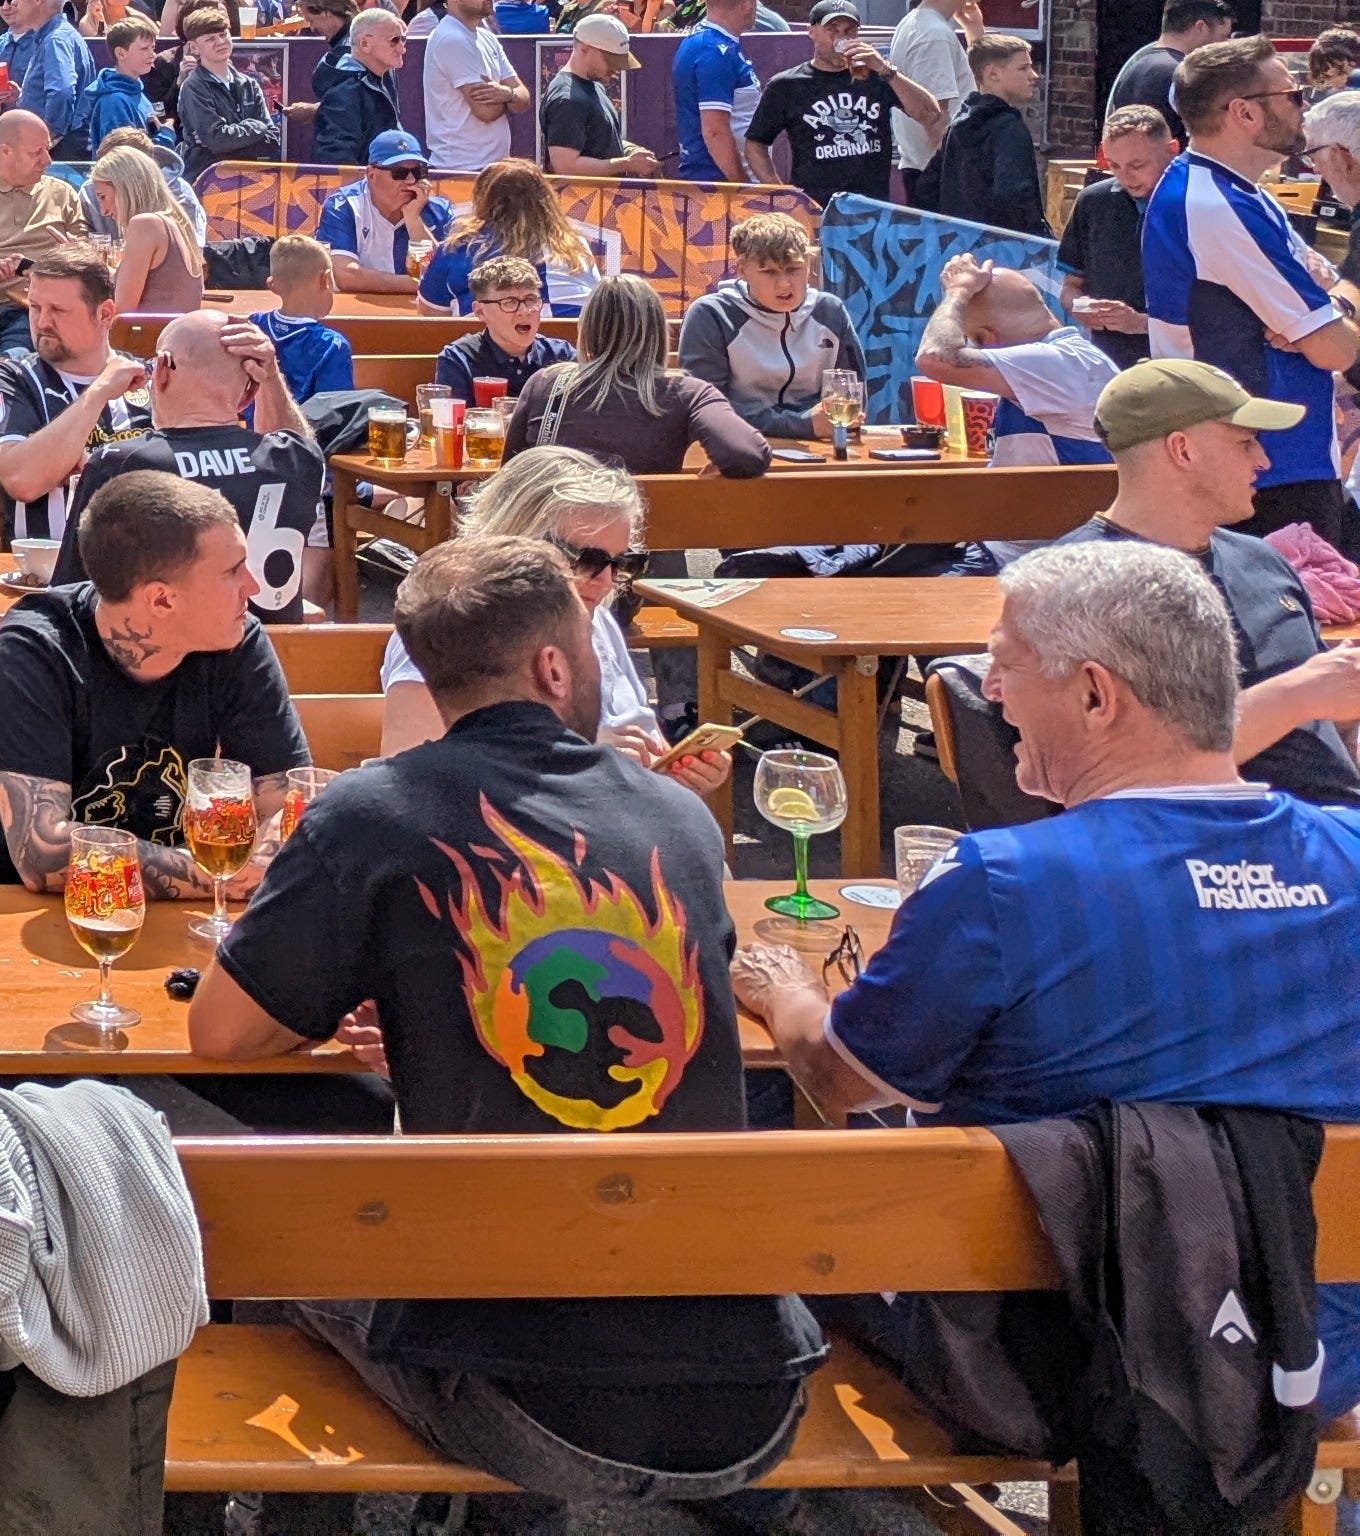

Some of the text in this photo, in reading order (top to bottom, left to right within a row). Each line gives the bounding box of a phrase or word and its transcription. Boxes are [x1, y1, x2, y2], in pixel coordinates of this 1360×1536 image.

[802, 92, 881, 129] ADIDAS
[815, 139, 882, 160] ORIGINALS
[174, 447, 257, 478] DAVE
[1185, 859, 1274, 888] Poplar
[1197, 880, 1328, 910] Insulation
